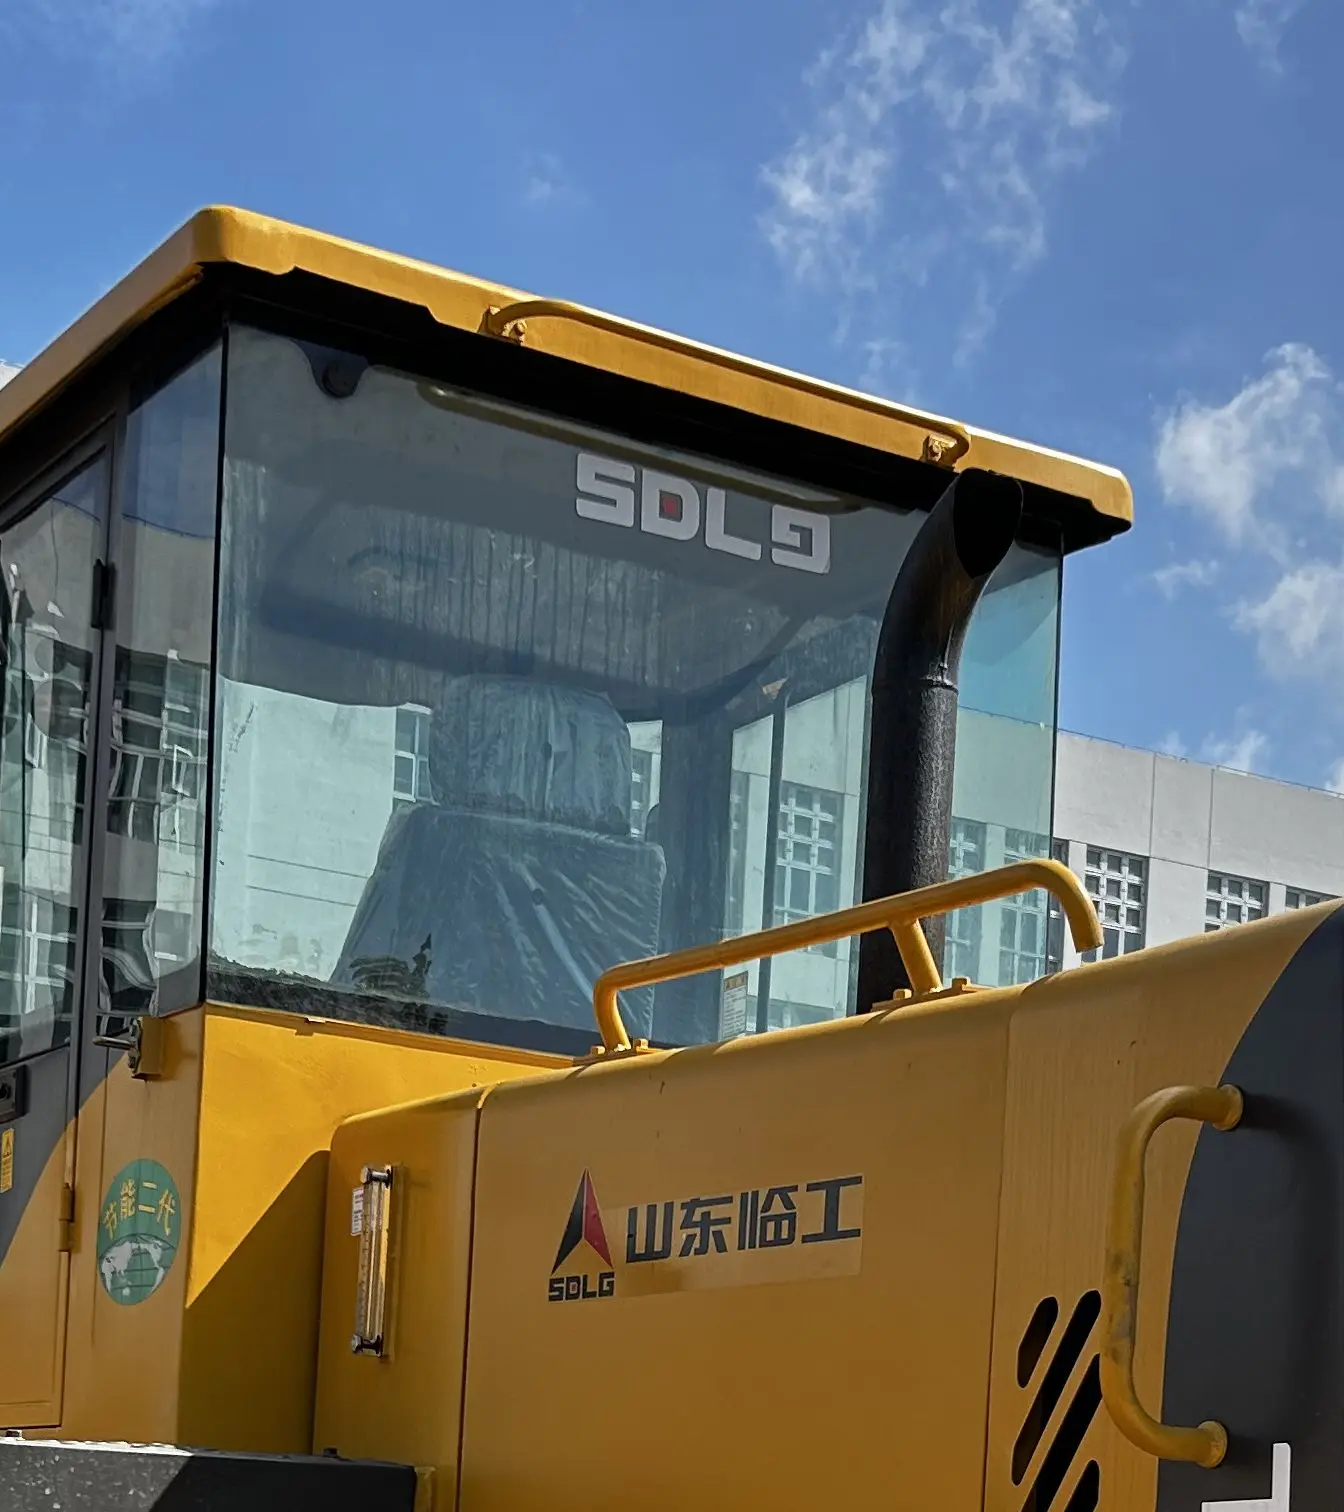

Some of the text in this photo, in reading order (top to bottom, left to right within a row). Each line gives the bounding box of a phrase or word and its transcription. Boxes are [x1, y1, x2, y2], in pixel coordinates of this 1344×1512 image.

[626, 1175, 863, 1264] 山东临工
[548, 1271, 615, 1302] SDLG
